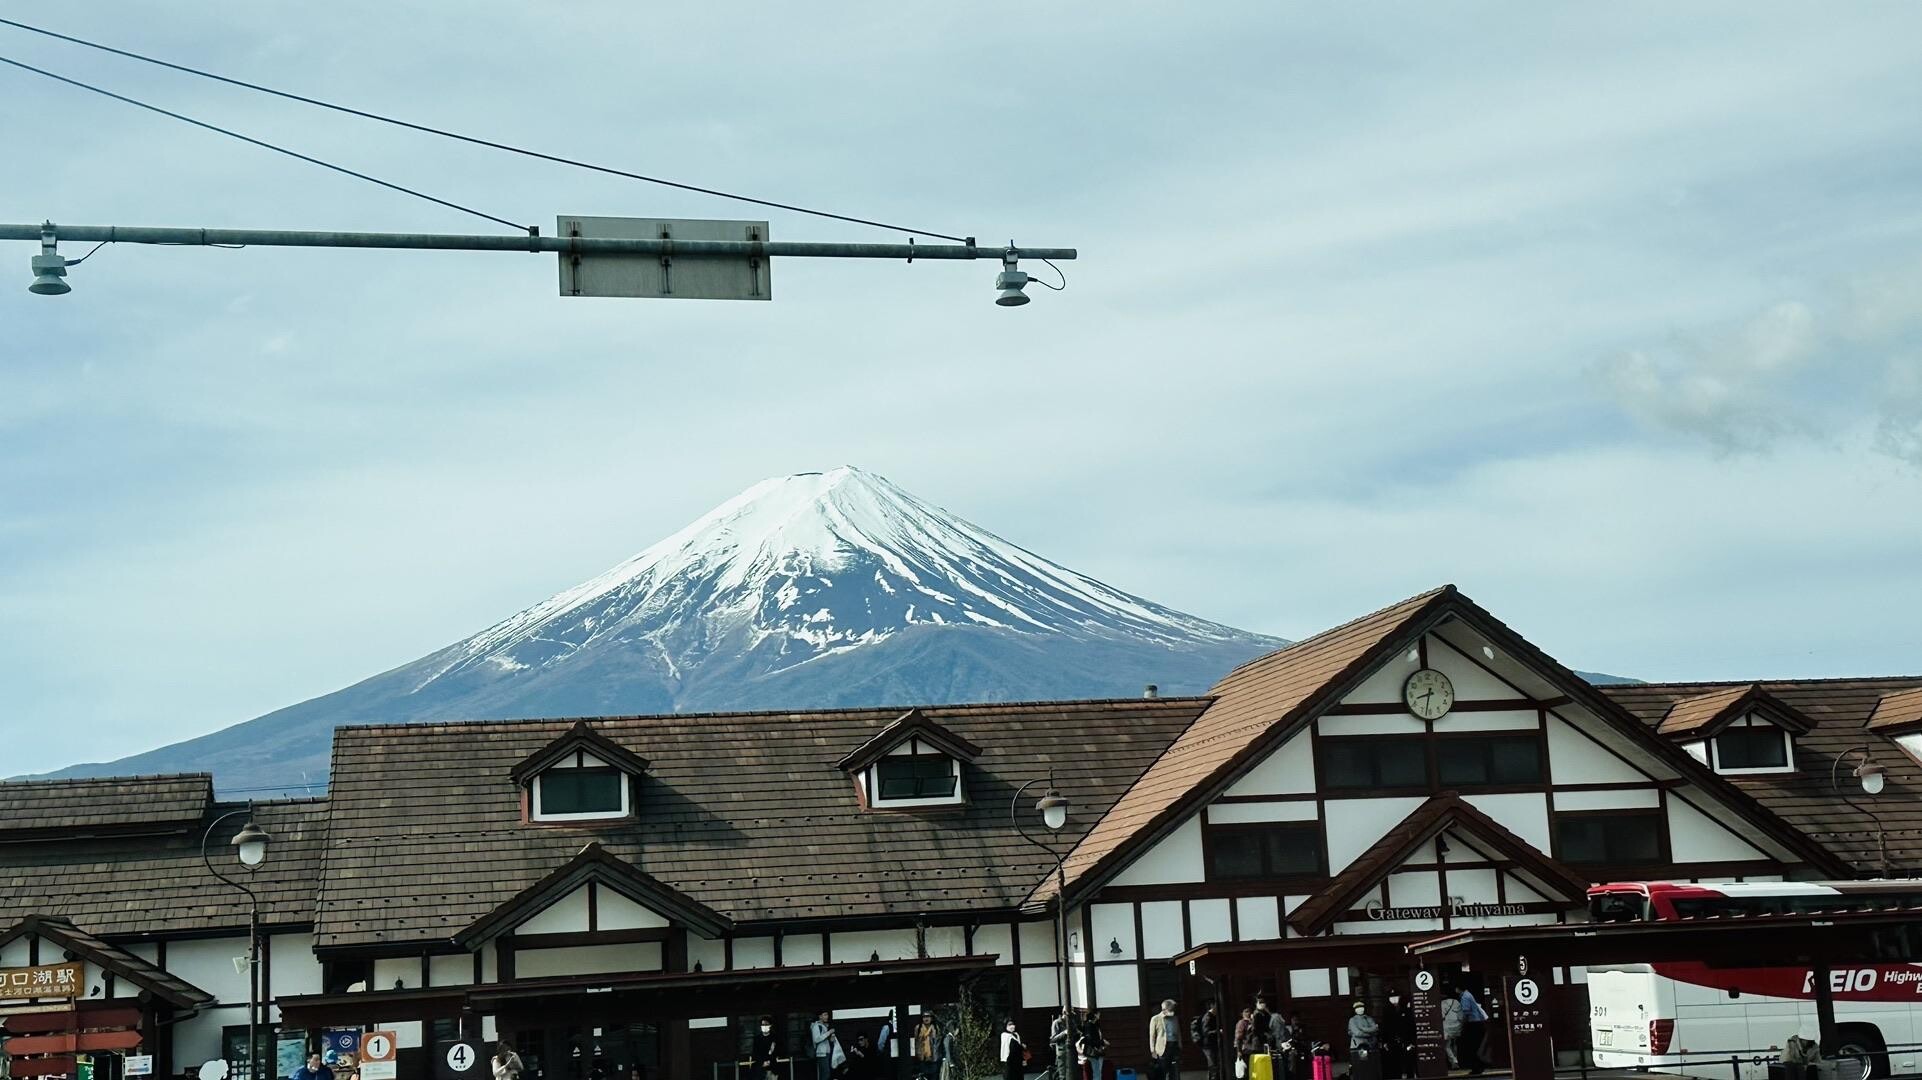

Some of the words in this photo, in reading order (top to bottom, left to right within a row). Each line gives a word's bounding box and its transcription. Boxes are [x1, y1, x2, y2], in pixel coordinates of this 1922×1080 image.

[1366, 900, 1442, 921] Gateway
[1449, 896, 1526, 920] Fujiyama
[1420, 973, 1429, 985] 2
[1521, 981, 1531, 998] 5
[374, 1038, 380, 1052] 1
[453, 1046, 466, 1064] 4
